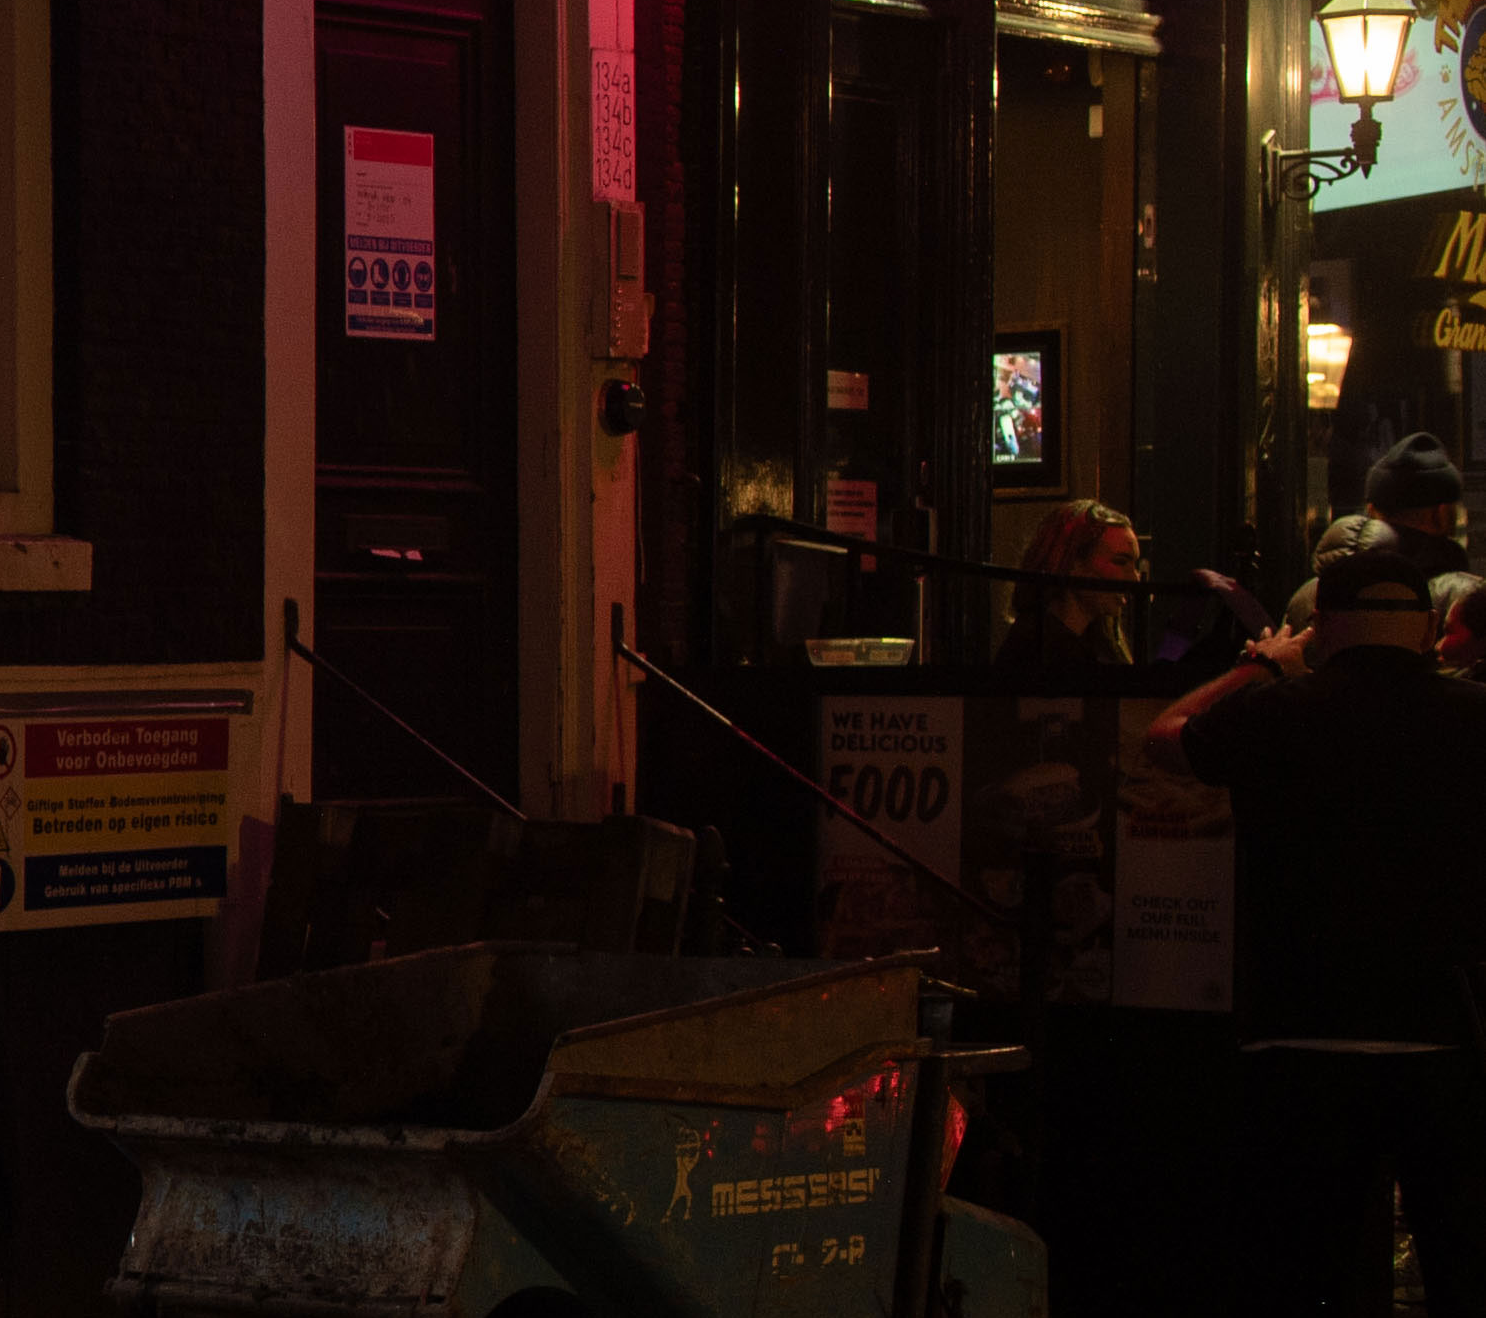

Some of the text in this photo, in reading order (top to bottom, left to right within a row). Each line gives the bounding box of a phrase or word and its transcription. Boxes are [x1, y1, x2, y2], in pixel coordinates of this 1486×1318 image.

[596, 61, 631, 94] 134a
[596, 93, 632, 126] 134b
[597, 125, 632, 158] 134c
[597, 157, 632, 190] 134d
[831, 711, 929, 731] WE HAVE
[56, 726, 199, 747] Verboden Toegang
[831, 732, 949, 754] DELICIOUS
[55, 749, 197, 770] voor Onbevoegden
[828, 763, 950, 823] FOOD
[33, 809, 218, 835] Betreden op eigen risico
[59, 864, 99, 878] Melden
[101, 861, 115, 878] bij
[117, 861, 132, 874] de
[44, 883, 87, 899] Gebruik
[90, 882, 109, 895] van
[1131, 895, 1219, 912] CHECK OUT
[1140, 911, 1173, 925] OUR
[1126, 927, 1221, 943] MENU INSIDE
